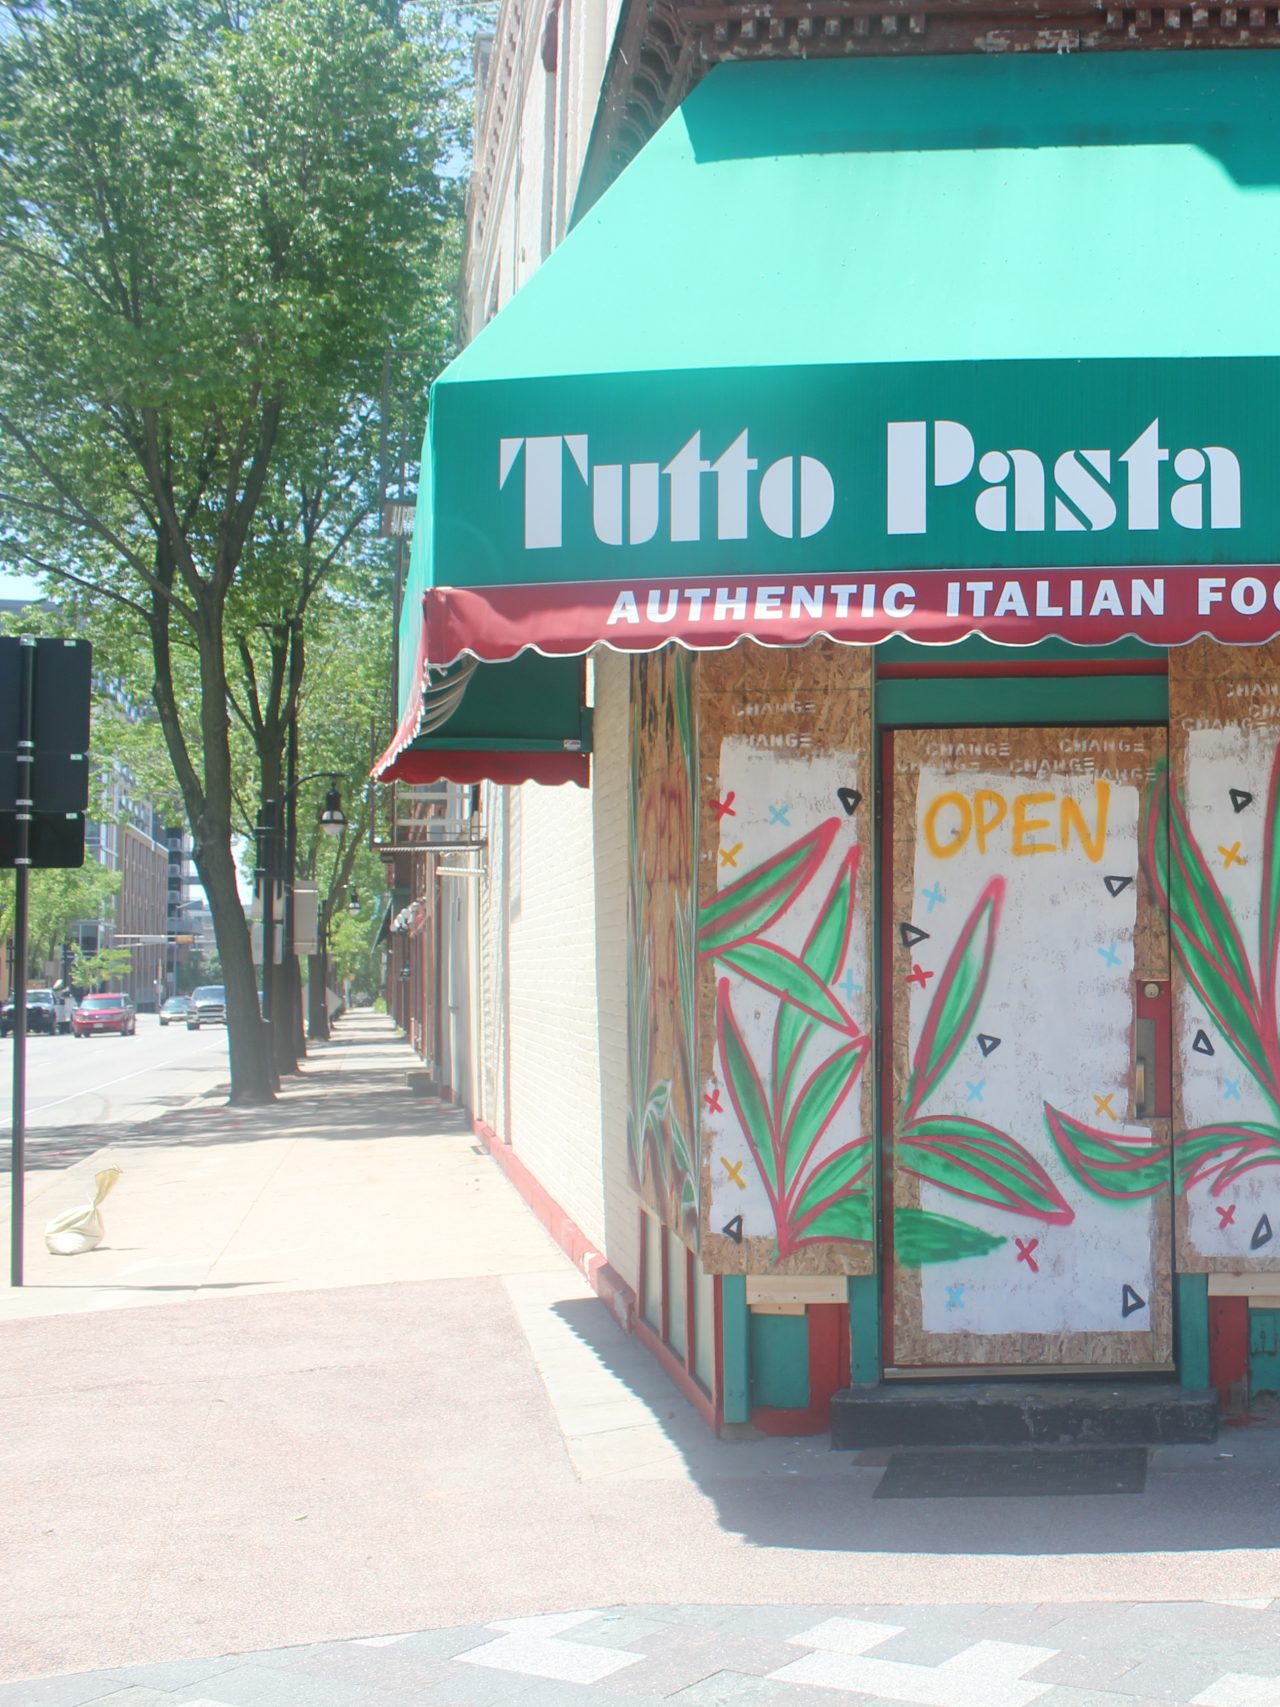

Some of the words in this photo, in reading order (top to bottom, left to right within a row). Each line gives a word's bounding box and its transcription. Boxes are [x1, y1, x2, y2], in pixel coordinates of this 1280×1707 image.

[499, 427, 835, 549] Tutto
[887, 417, 1241, 535] Pasta
[606, 583, 916, 625] AUTHENTIC
[946, 578, 1164, 617] ITALIAN
[731, 701, 816, 717] CHANGE
[926, 742, 1010, 757] CHANGE
[1059, 738, 1144, 753] CHANGE
[1010, 757, 1095, 772] CHANGE
[923, 778, 1111, 863] OPEN
